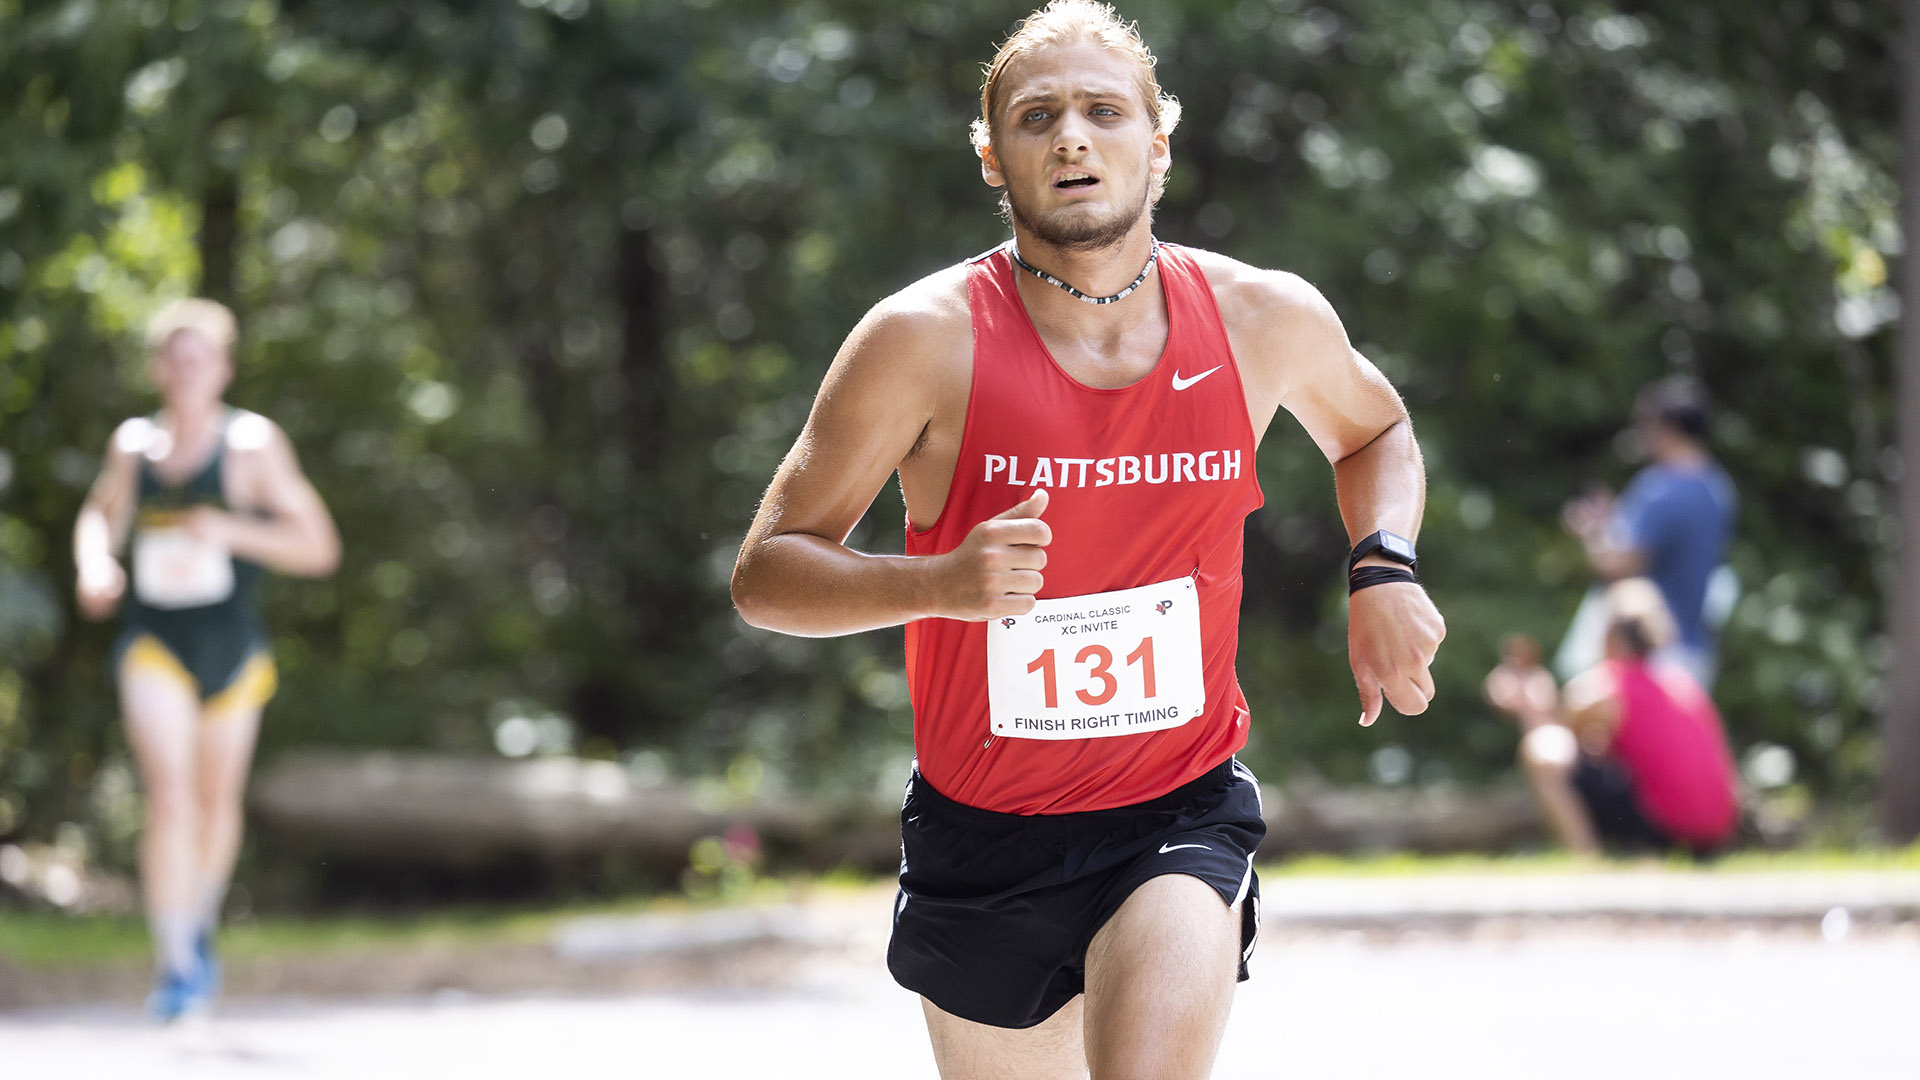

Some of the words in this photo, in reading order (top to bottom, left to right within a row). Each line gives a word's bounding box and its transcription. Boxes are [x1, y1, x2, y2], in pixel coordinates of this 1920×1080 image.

[984, 449, 1241, 488] PLATTSBURGH
[1034, 610, 1086, 624] CARDINAL
[1088, 605, 1131, 619] CLASSIC
[1061, 625, 1078, 636] XC
[1080, 620, 1118, 633] INVITE
[1026, 635, 1157, 709] 131
[1014, 717, 1066, 731] FINISH
[1070, 714, 1120, 730] RIGHT
[1124, 705, 1179, 726] TIMING
